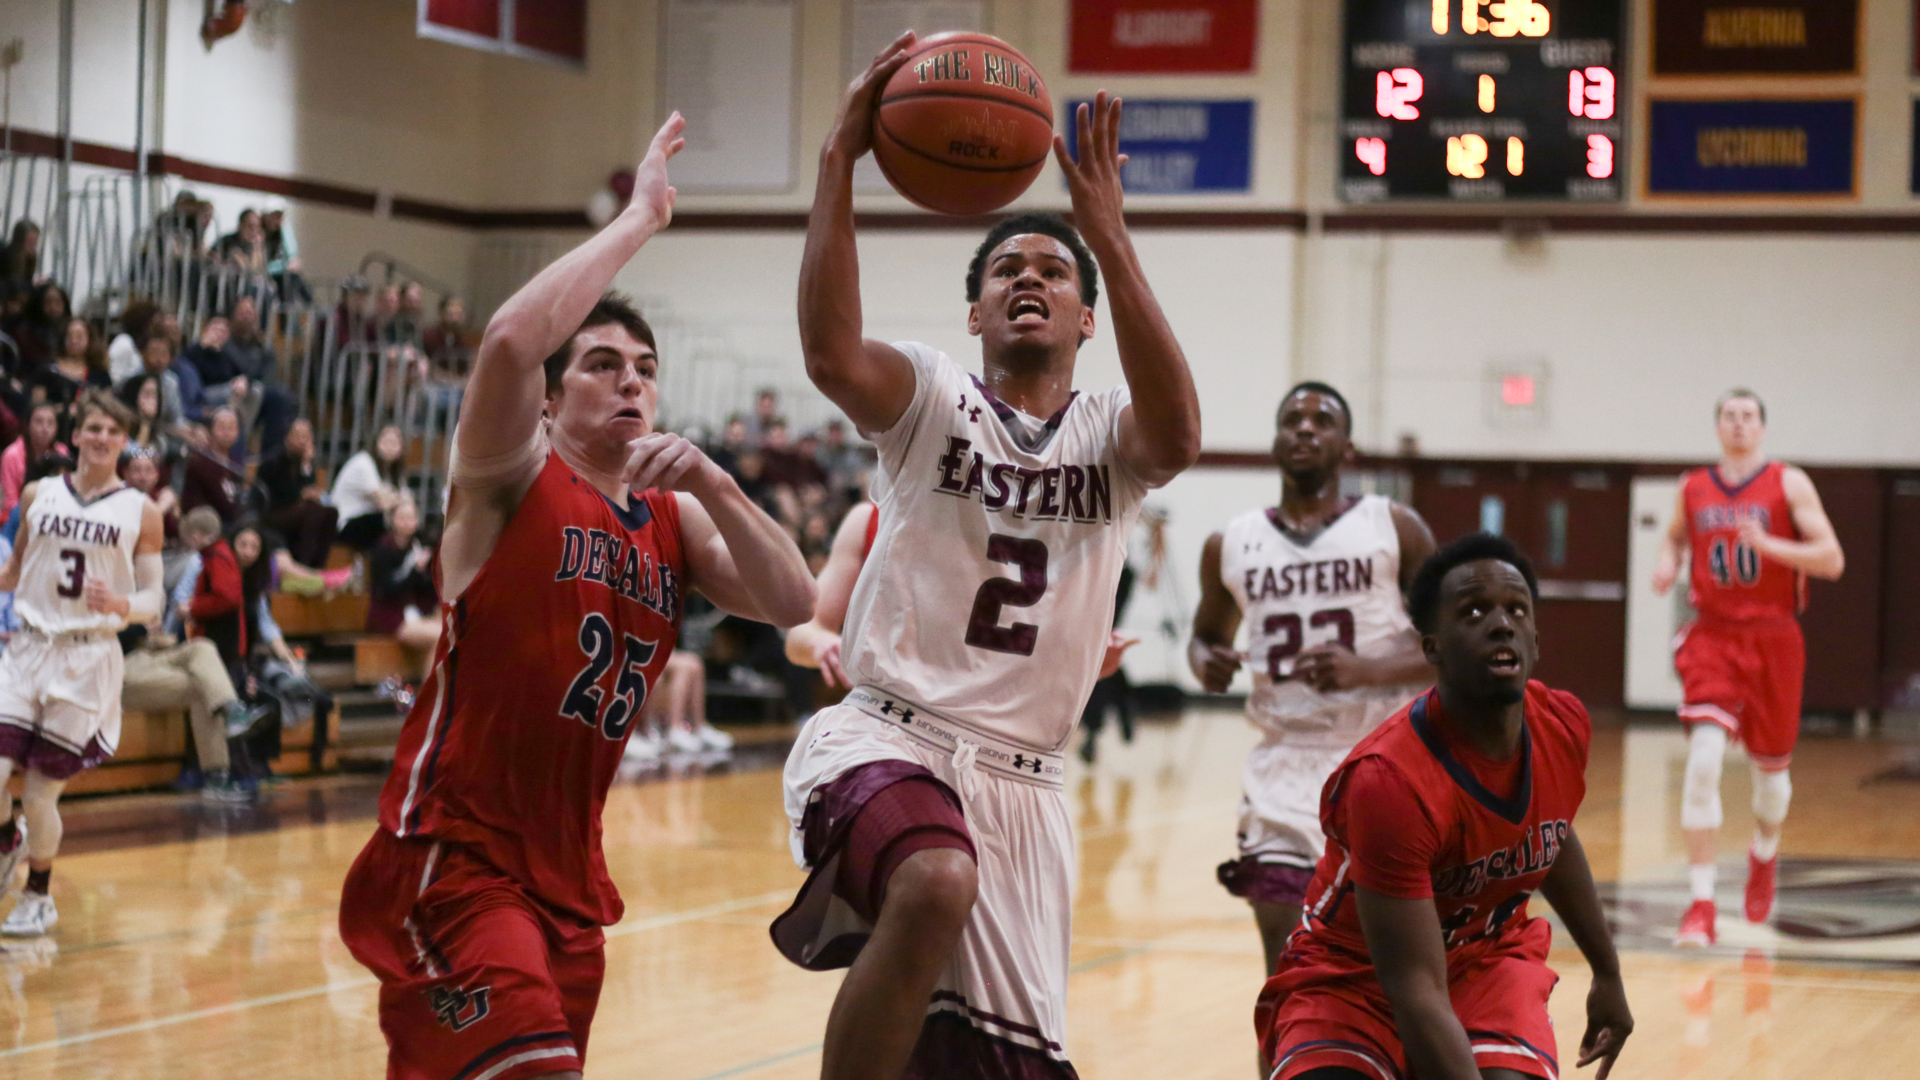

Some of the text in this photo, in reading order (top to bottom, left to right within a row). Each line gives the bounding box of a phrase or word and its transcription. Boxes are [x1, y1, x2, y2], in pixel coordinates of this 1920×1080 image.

[914, 50, 1039, 98] THE ROCK
[1376, 68, 1423, 120] 12
[1478, 74, 1495, 113] 1
[1569, 66, 1615, 119] 13
[949, 140, 1001, 161] ROCK
[1355, 137, 1386, 175] 4
[1507, 136, 1524, 176] 1
[1586, 134, 1613, 178] 3
[933, 434, 1112, 525] EASTERN
[38, 514, 121, 547] EASTERN
[57, 550, 85, 598] 3
[1244, 557, 1374, 600] EASTERN
[1710, 538, 1759, 588] 40
[964, 533, 1048, 657] 2
[558, 612, 659, 740] 25
[977, 746, 1010, 762] UNDE
